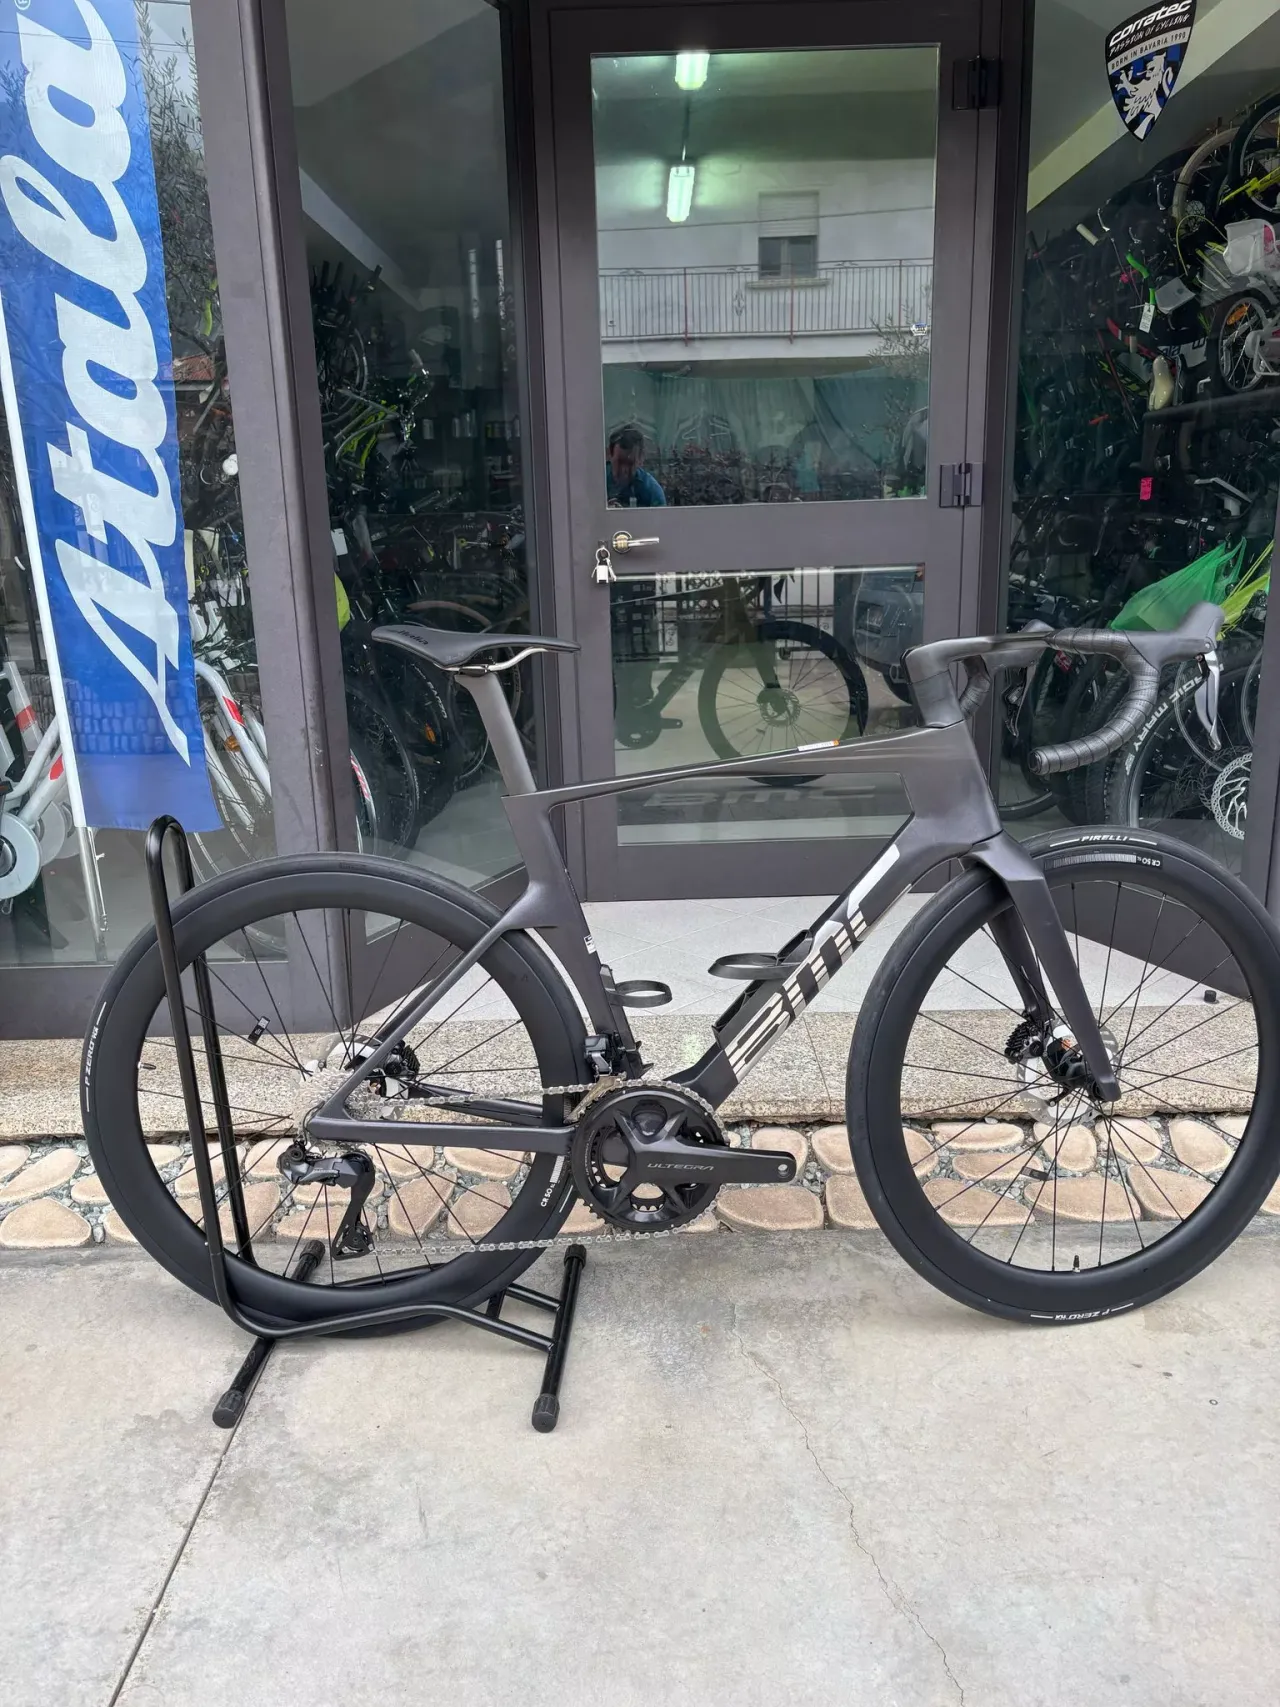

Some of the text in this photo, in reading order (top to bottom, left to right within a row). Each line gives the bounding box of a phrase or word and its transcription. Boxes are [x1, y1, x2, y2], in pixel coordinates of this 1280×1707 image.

[1109, 0, 1192, 47] corratec
[1110, 13, 1190, 56] PASSION OF CYCLING
[1111, 55, 1128, 70] BORN
[1131, 50, 1138, 59] IN
[1139, 38, 1168, 55] BAVARIA
[0, 0, 190, 769] Atala
[1133, 675, 1207, 751] AGIC MARY
[1081, 834, 1128, 842] PIRELLI
[724, 843, 912, 1083] BMC
[85, 1041, 95, 1075] ZERO
[647, 1162, 714, 1171] ULTEGRA
[540, 1197, 549, 1207] CR
[544, 1188, 553, 1198] 50
[1069, 1311, 1100, 1319] ZERO
